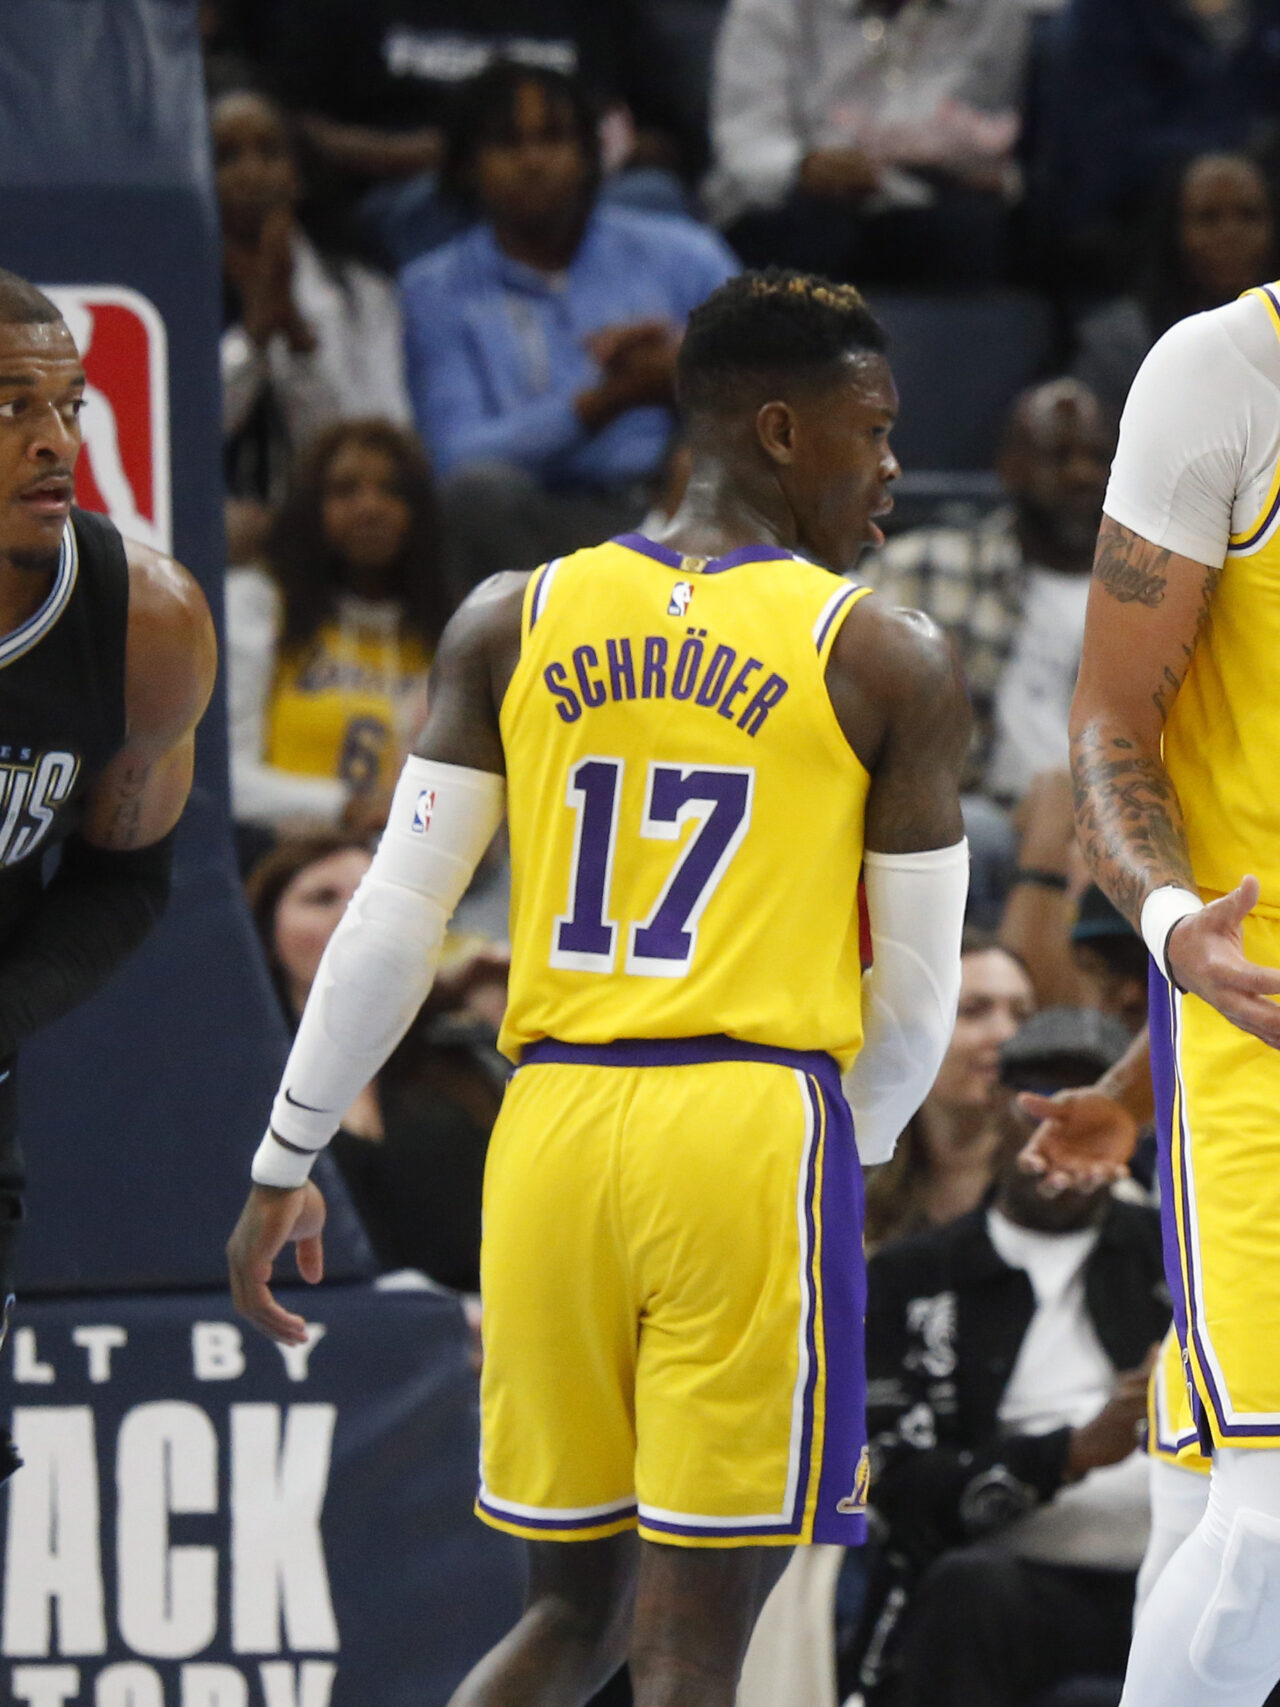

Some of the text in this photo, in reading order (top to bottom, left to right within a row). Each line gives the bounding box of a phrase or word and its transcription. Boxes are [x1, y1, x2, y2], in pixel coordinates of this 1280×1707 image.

[543, 627, 790, 738] SCHRÖDER
[340, 715, 388, 795] 6
[548, 754, 757, 978] 17
[191, 1321, 328, 1383] BY
